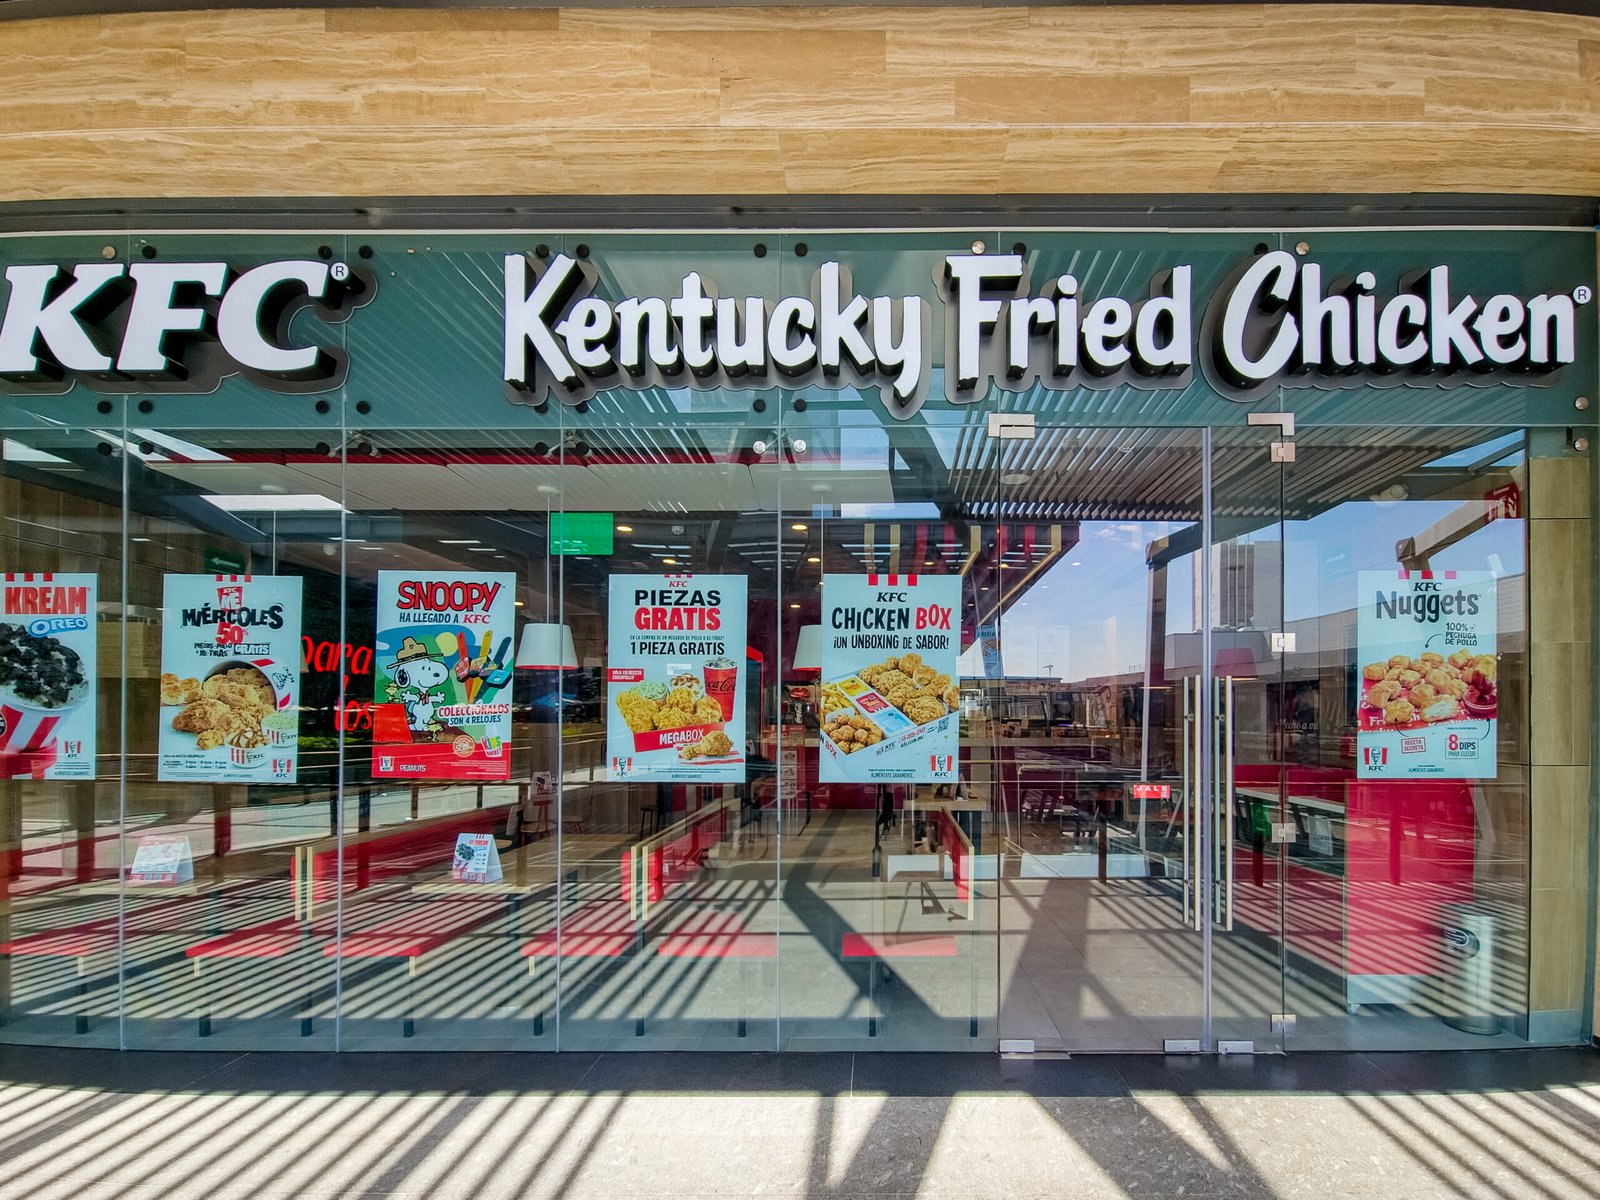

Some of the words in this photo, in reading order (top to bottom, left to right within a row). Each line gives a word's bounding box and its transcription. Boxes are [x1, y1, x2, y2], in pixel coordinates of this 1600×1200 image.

[0, 260, 328, 373] KFC
[504, 253, 921, 396] Kentucky
[945, 255, 1191, 389] Fried
[1222, 250, 1574, 379] Chicken
[669, 580, 688, 588] KFC
[1413, 582, 1442, 592] KFC
[5, 587, 86, 614] KREAM
[396, 580, 501, 612] SNOOPY
[635, 590, 721, 606] PIEZAS
[876, 592, 908, 602] KFC
[1376, 590, 1479, 623] Nuggets
[399, 613, 412, 624] HA
[413, 613, 451, 624] LLEGADO
[453, 614, 459, 624] A
[463, 614, 490, 624] KFC
[635, 607, 721, 631] GRATIS
[831, 607, 910, 632] CHICKEN
[915, 604, 952, 630] BOX
[31, 619, 87, 636] OREO
[1446, 623, 1469, 632] 100%
[833, 636, 848, 648] ¡UN
[851, 634, 899, 649] UNBOXING
[902, 637, 912, 649] DE
[916, 634, 949, 649] SABOR!
[1445, 632, 1477, 640] PECHUGA
[234, 645, 268, 655] GRATIS
[631, 642, 636, 655] 1
[640, 642, 675, 655] PIEZA
[680, 642, 725, 655] GRATIS
[450, 717, 464, 726] SON
[465, 716, 470, 725] 4
[472, 714, 501, 725] RELOJES
[659, 729, 704, 745] MEGABOX
[1448, 734, 1459, 751] 8
[1459, 742, 1476, 751] DIPS
